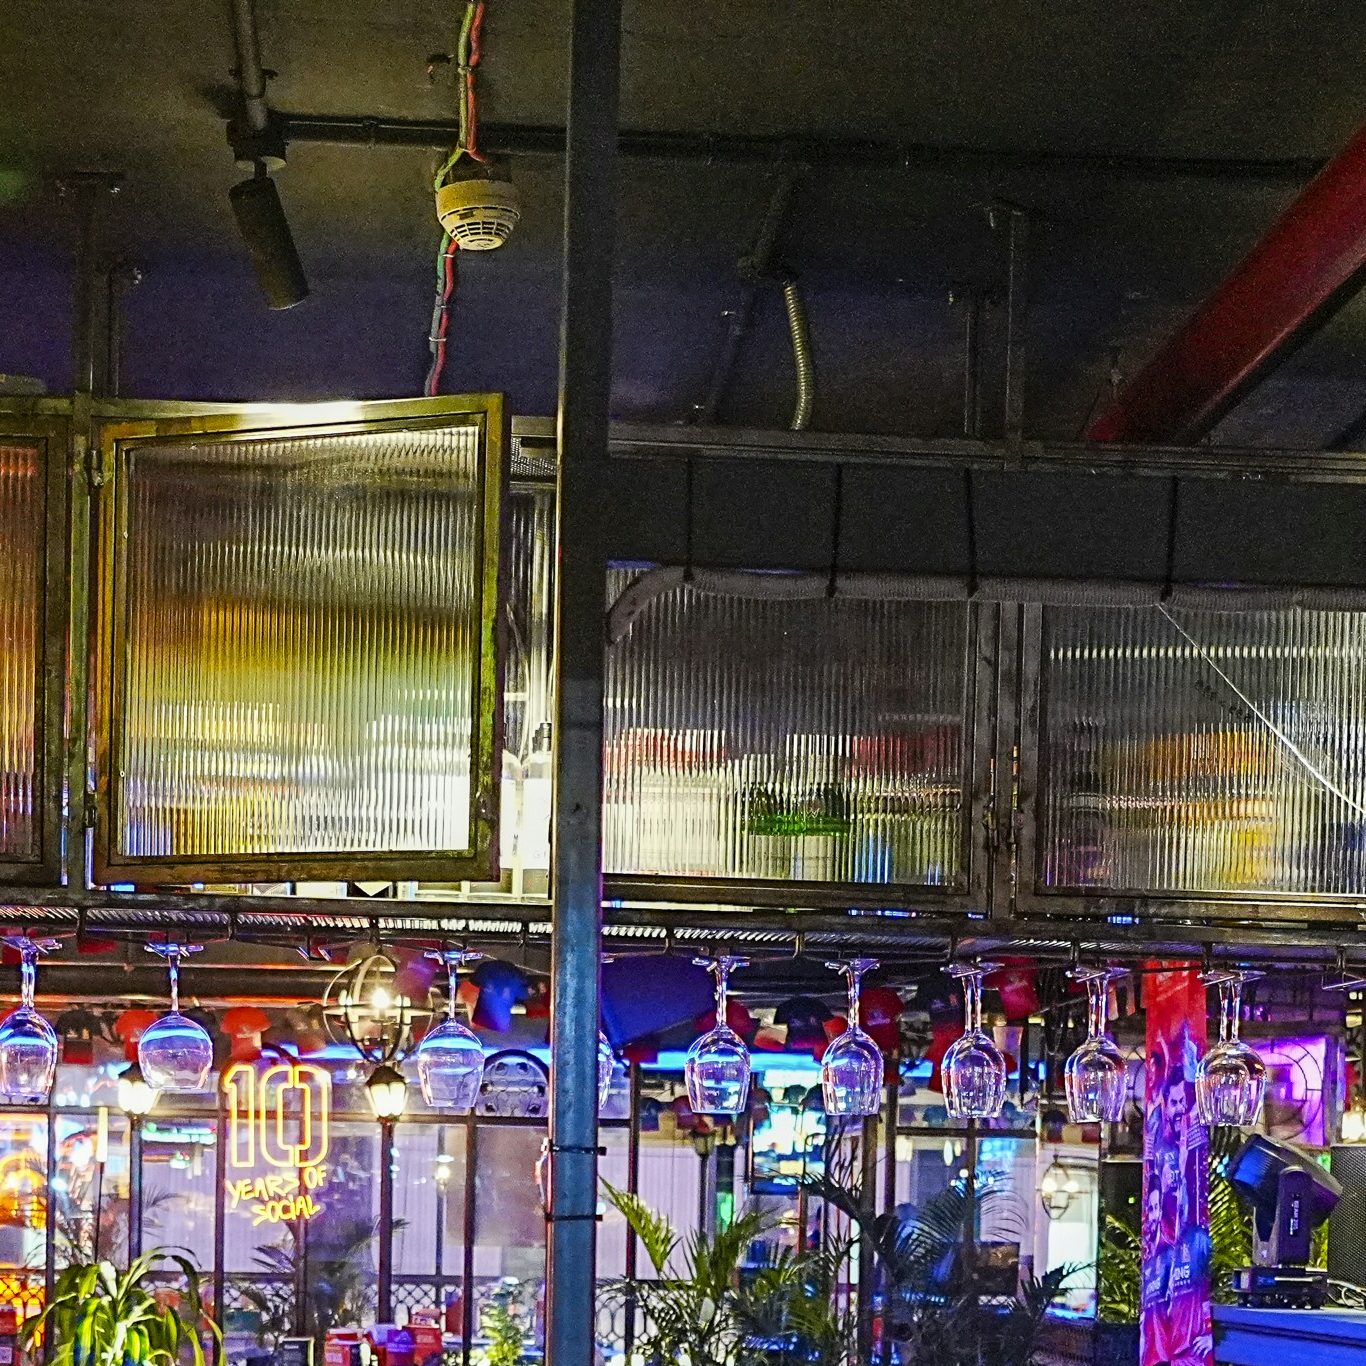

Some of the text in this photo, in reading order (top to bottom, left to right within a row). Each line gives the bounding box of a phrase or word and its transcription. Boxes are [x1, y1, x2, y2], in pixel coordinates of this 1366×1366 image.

[223, 1063, 331, 1168] 10
[225, 1165, 327, 1209] YEARS OF
